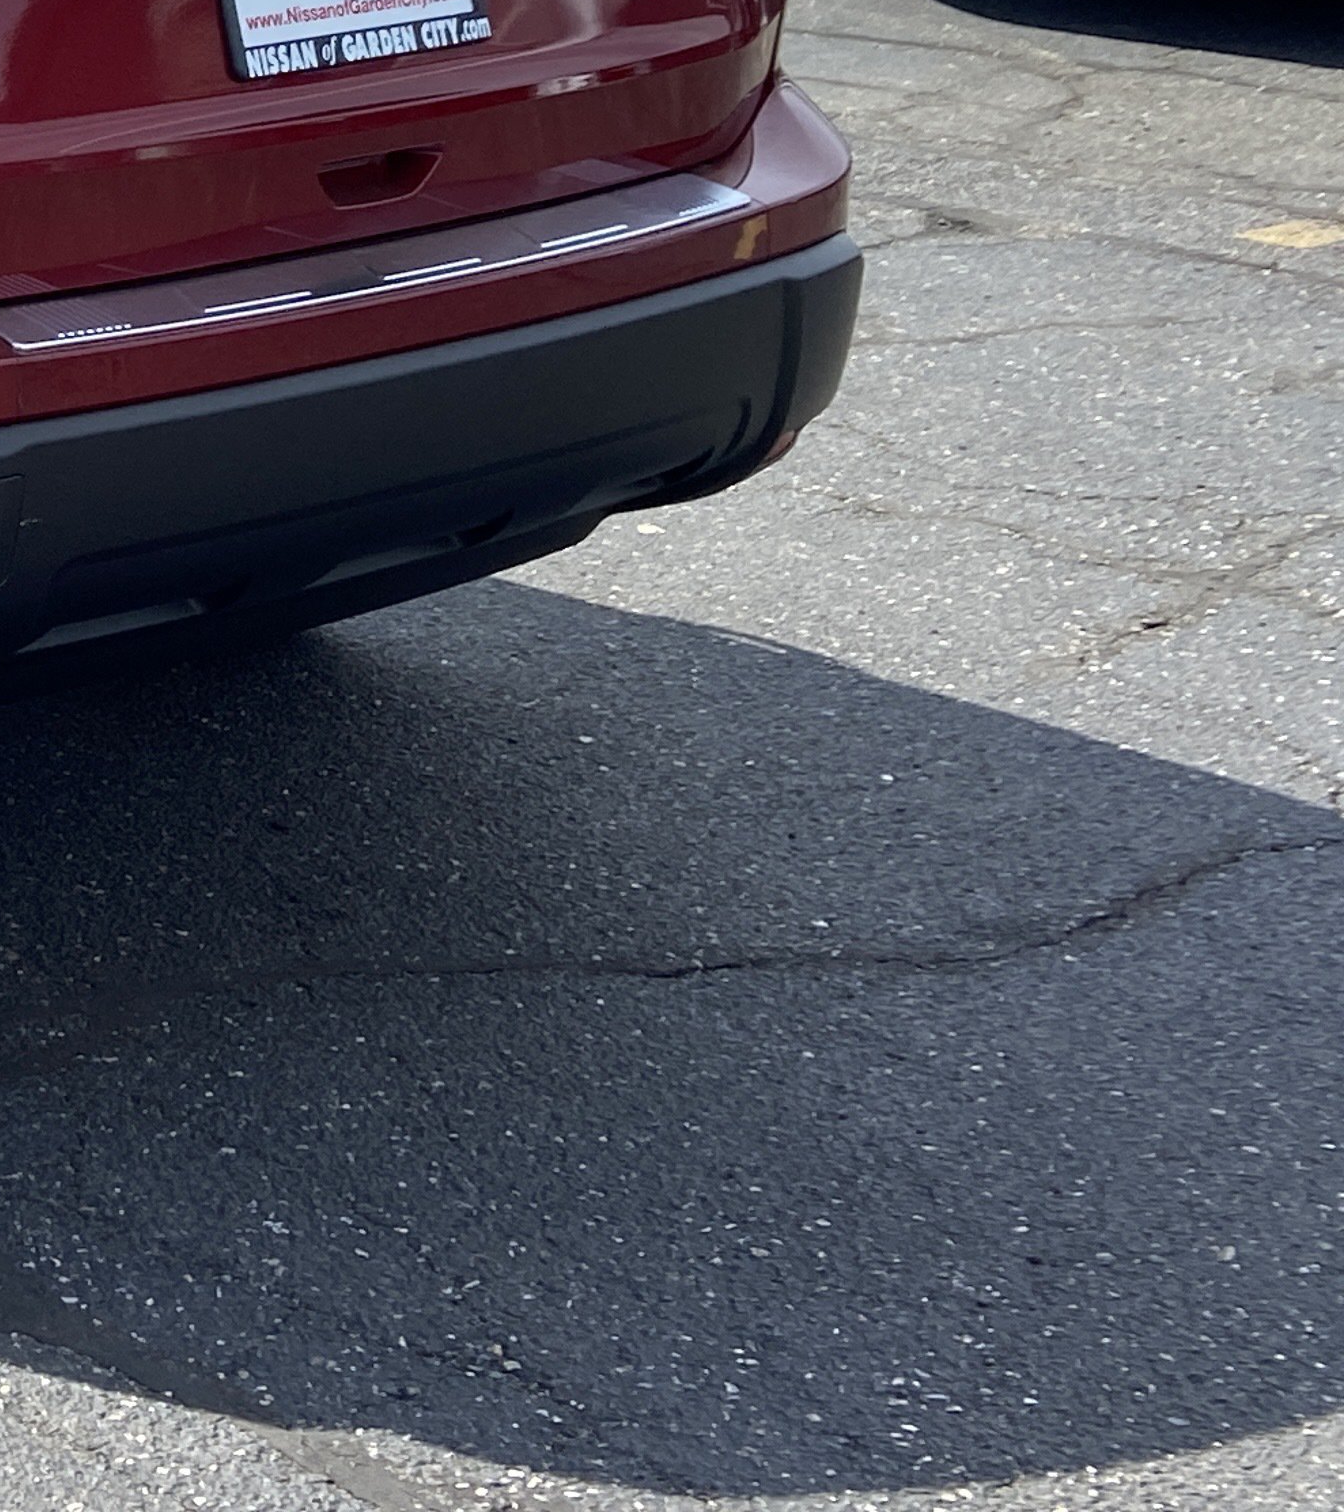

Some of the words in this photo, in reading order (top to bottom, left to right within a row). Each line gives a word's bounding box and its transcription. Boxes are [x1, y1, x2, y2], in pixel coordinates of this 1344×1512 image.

[245, 36, 318, 78] NISSAN
[322, 35, 337, 65] of
[341, 25, 417, 62] GARDEN
[421, 16, 492, 49] CITY.com
